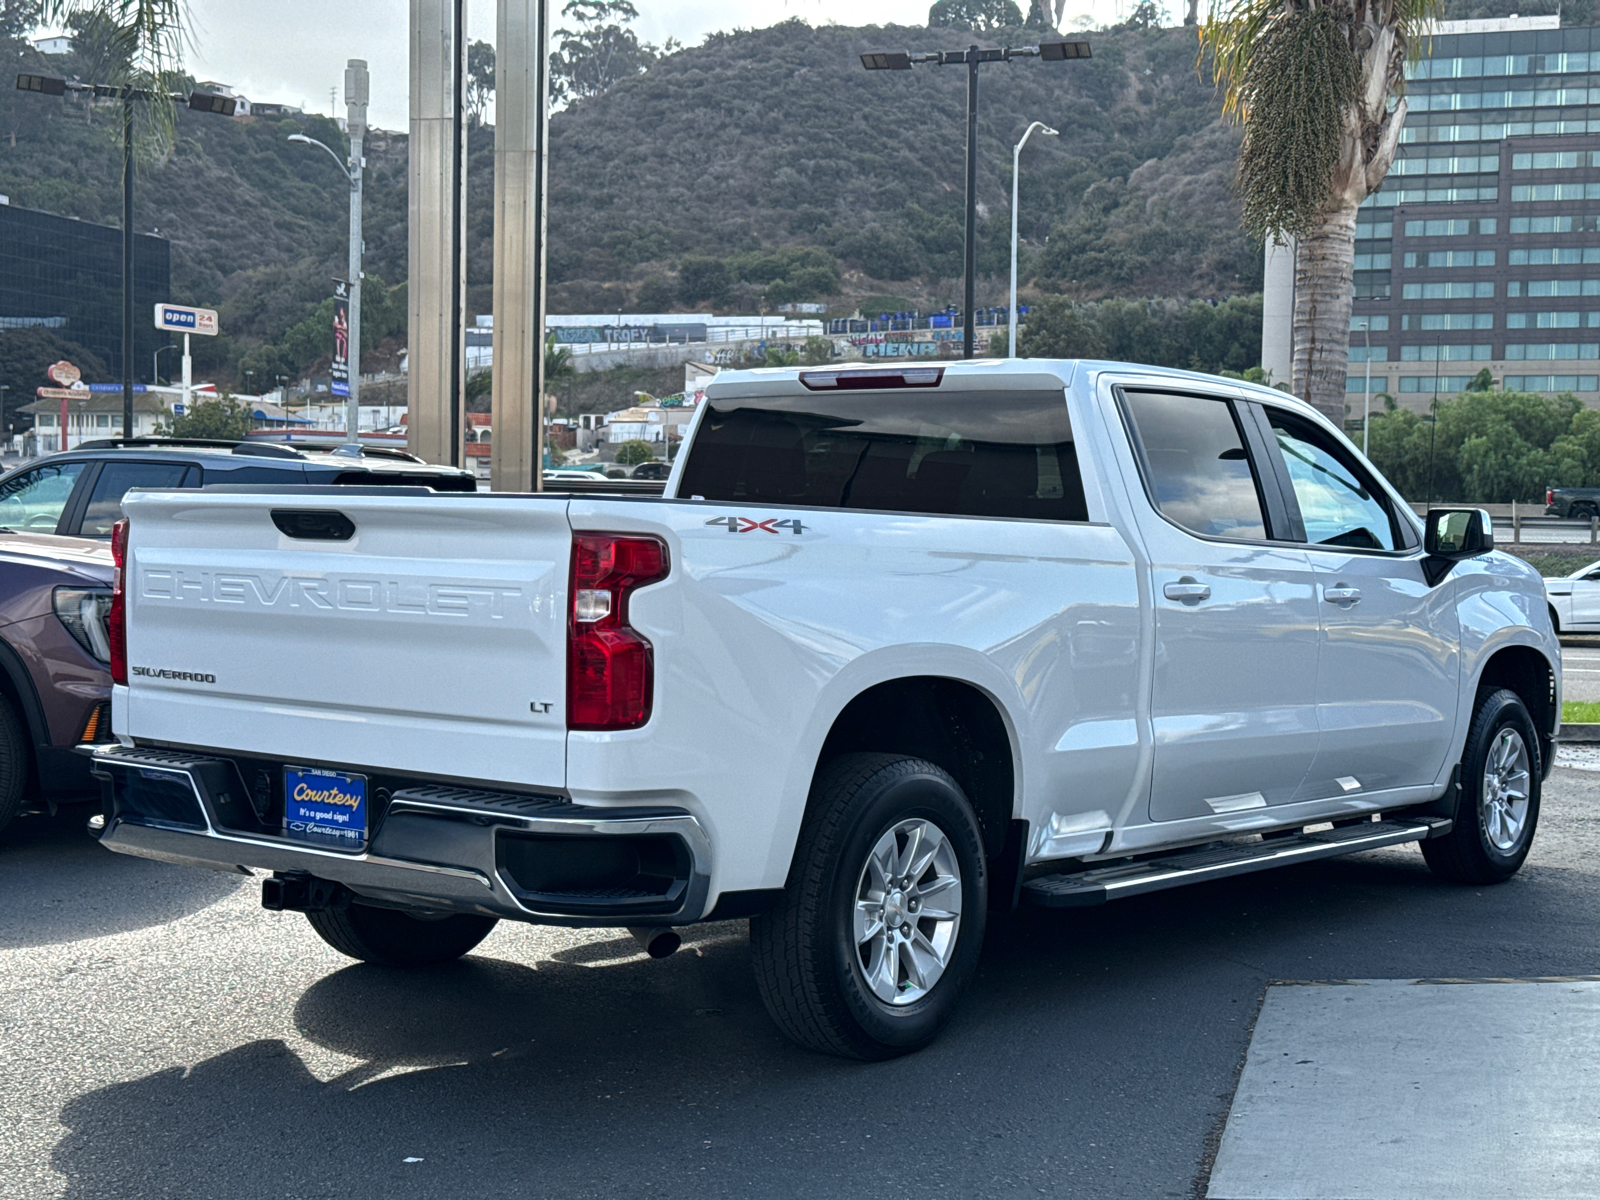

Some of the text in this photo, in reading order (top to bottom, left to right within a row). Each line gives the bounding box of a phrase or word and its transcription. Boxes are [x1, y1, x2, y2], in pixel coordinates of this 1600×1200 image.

[165, 312, 194, 322] open
[198, 314, 213, 322] 24
[142, 570, 522, 619] CHEVROLET
[132, 666, 216, 684] SILVERADO
[530, 701, 554, 714] LT
[322, 770, 337, 778] DIEGO
[294, 783, 361, 811] Courtesy
[299, 807, 309, 817] It's
[316, 811, 333, 820] good
[333, 812, 349, 823] sign!
[306, 822, 340, 837] Courtesy
